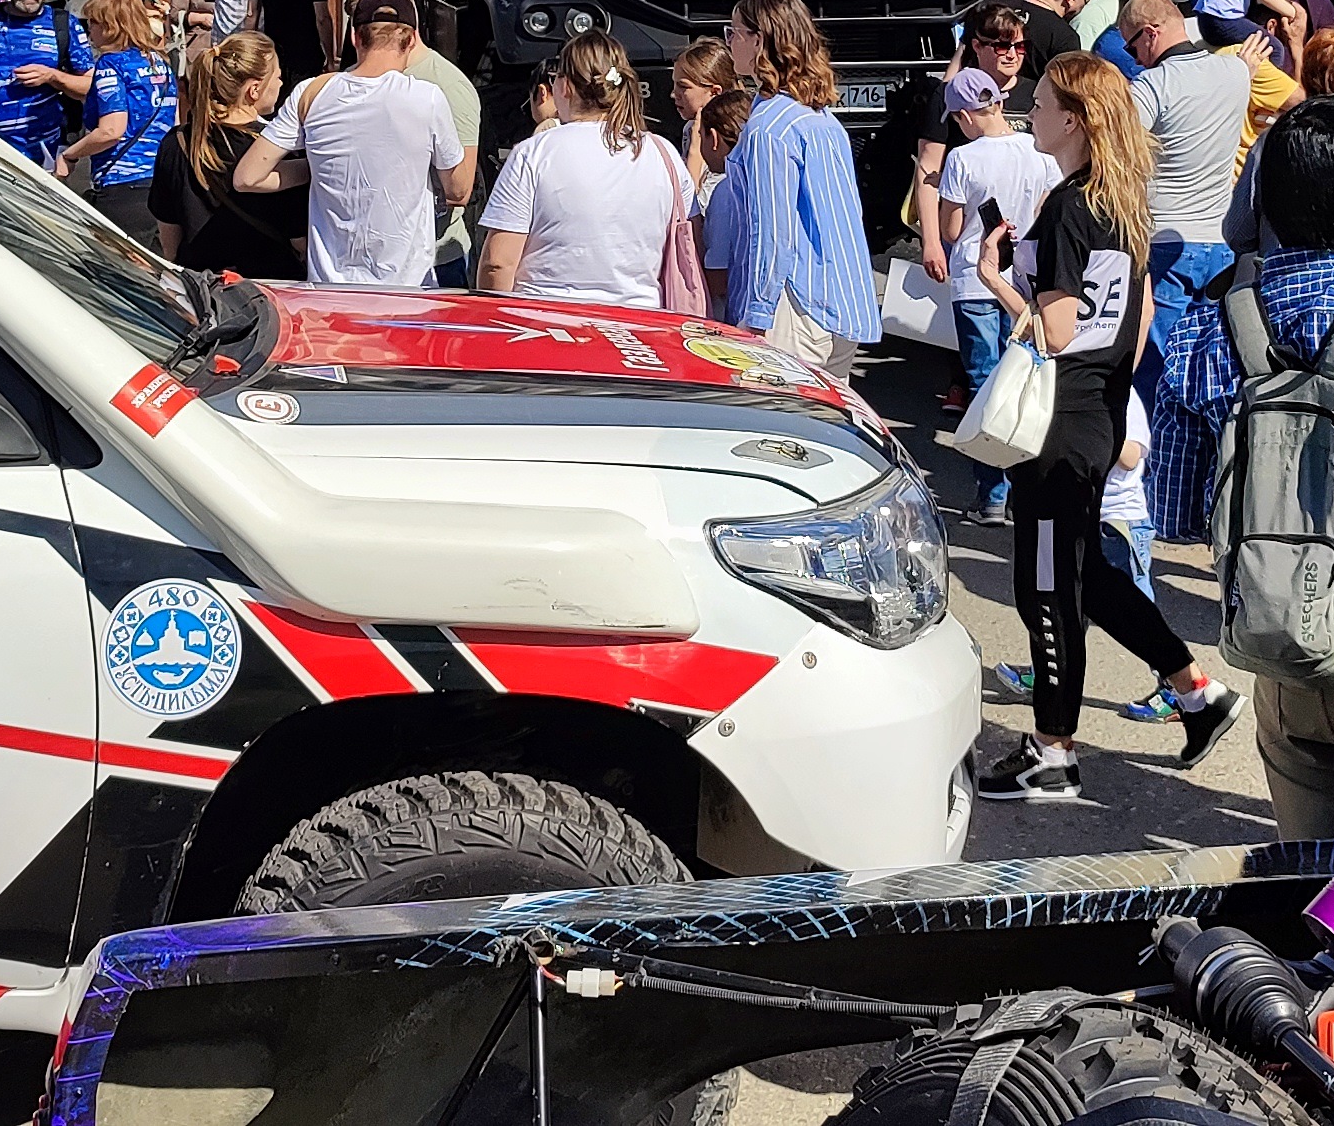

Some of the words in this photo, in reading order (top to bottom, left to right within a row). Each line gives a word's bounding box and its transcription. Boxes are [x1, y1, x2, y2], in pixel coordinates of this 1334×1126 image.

[851, 86, 880, 104] 716
[148, 586, 200, 608] 480
[1301, 561, 1319, 644] SKECHERS
